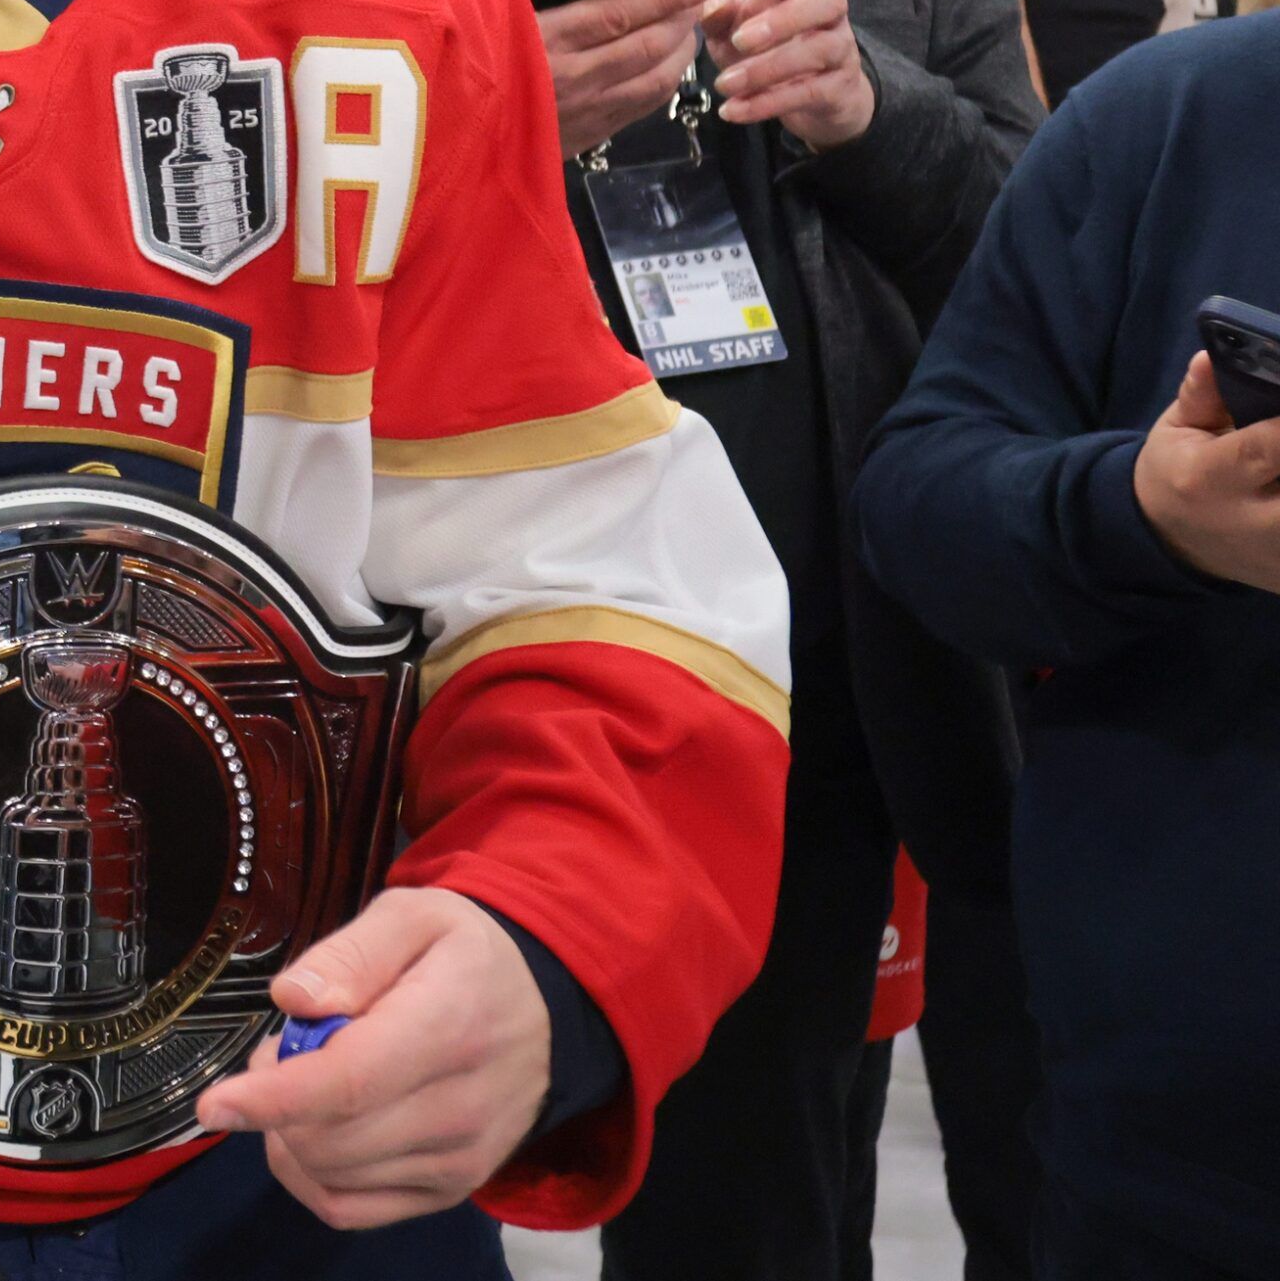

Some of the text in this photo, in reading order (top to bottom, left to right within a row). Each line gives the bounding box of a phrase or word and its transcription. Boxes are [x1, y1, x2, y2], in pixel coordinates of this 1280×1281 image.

[144, 108, 259, 139] 20 25
[292, 35, 428, 287] A
[654, 335, 775, 371] NHL STAFF
[72, 906, 247, 1050] CHAMPIONS
